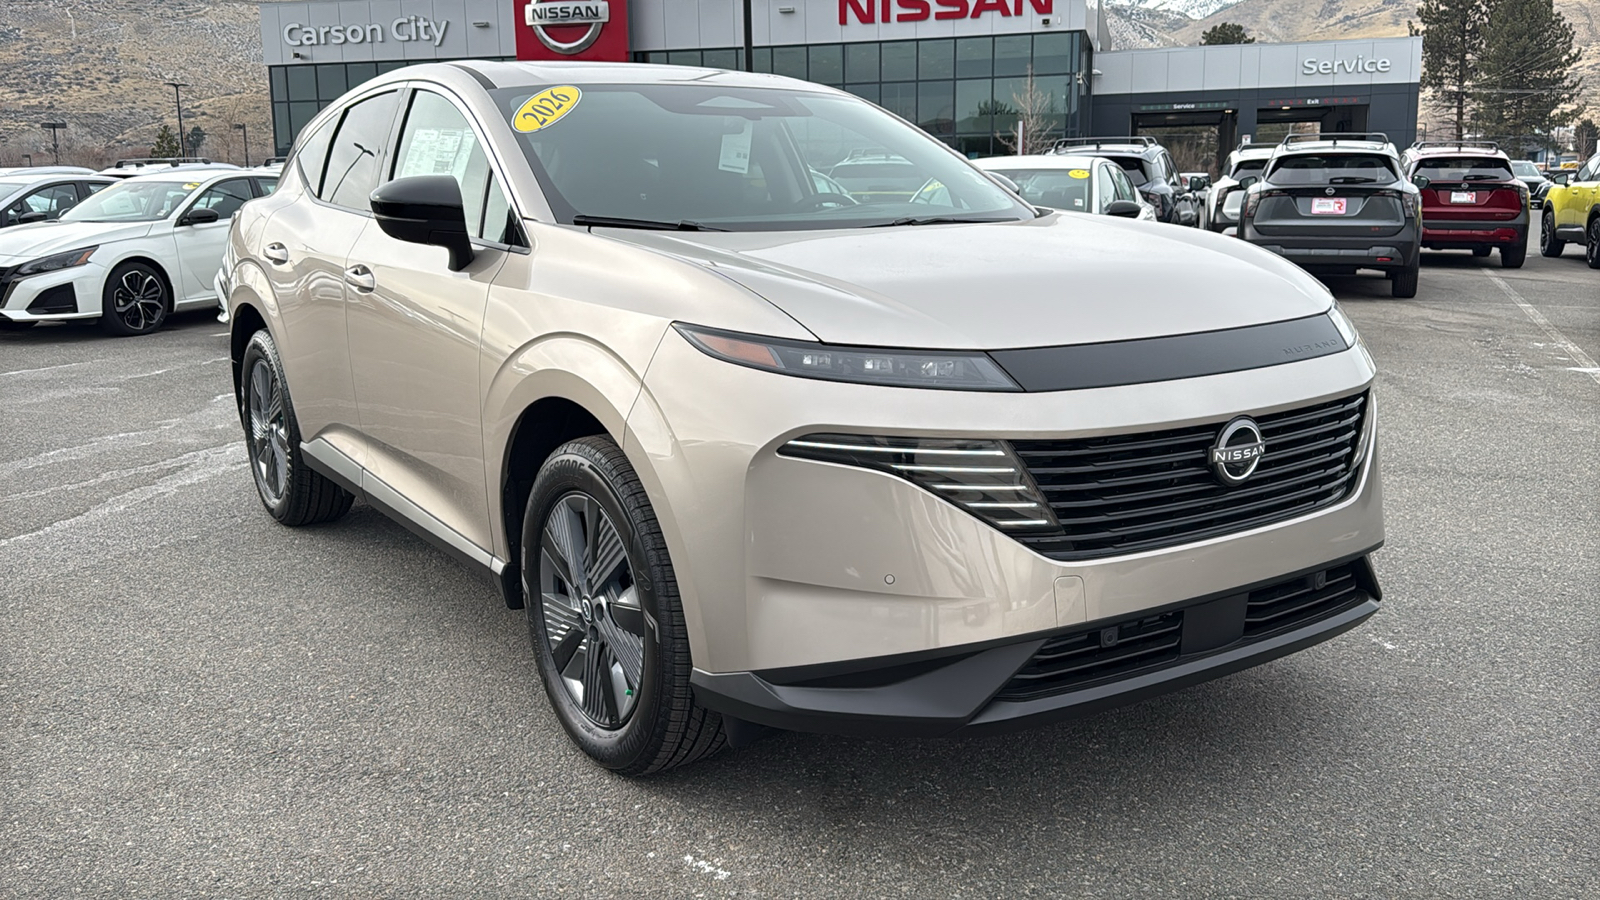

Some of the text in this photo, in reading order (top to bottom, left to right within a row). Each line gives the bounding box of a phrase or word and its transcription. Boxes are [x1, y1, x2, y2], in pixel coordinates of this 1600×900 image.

[532, 6, 599, 20] NISSAN
[283, 15, 448, 47] Carson City
[1303, 54, 1391, 75] Service
[522, 90, 570, 126] 2026
[1282, 339, 1338, 355] MURANO
[1215, 444, 1265, 461] NISSAN
